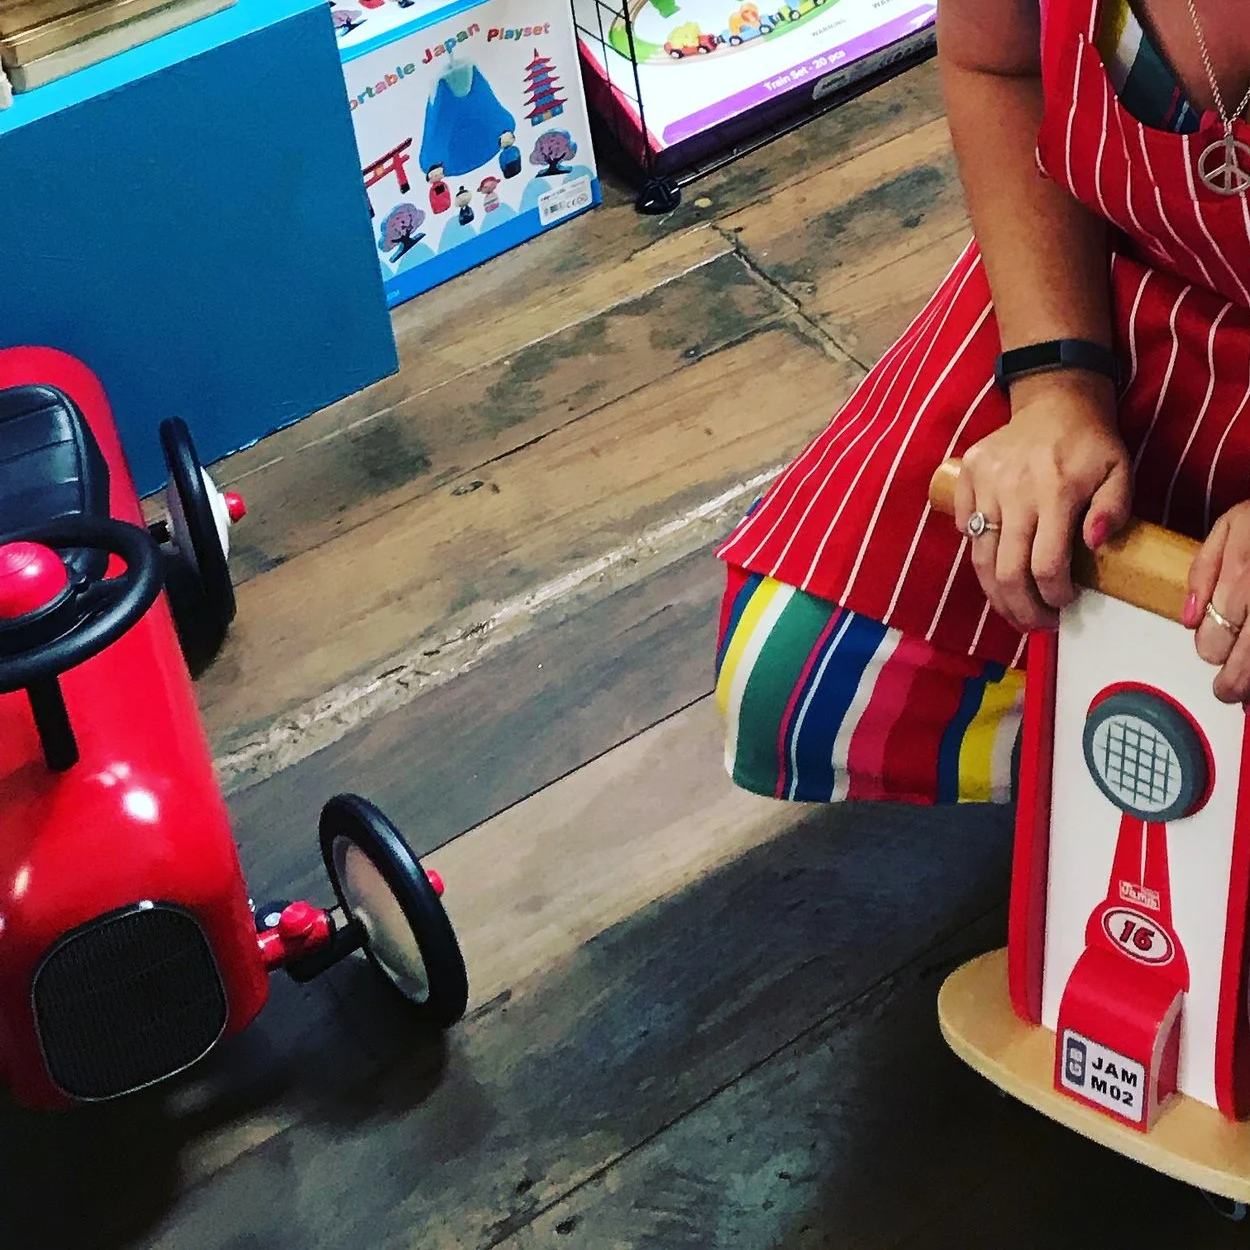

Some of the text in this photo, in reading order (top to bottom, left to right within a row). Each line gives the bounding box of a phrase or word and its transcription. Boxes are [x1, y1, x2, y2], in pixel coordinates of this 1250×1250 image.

[350, 22, 550, 111] ortable Japan Playset
[764, 71, 791, 92] Train
[791, 65, 809, 80] Set
[813, 57, 828, 71] 20
[829, 50, 847, 66] pcs
[1119, 919, 1155, 952] 16
[1092, 1057, 1138, 1088] JAM
[1090, 1075, 1135, 1106] M02
